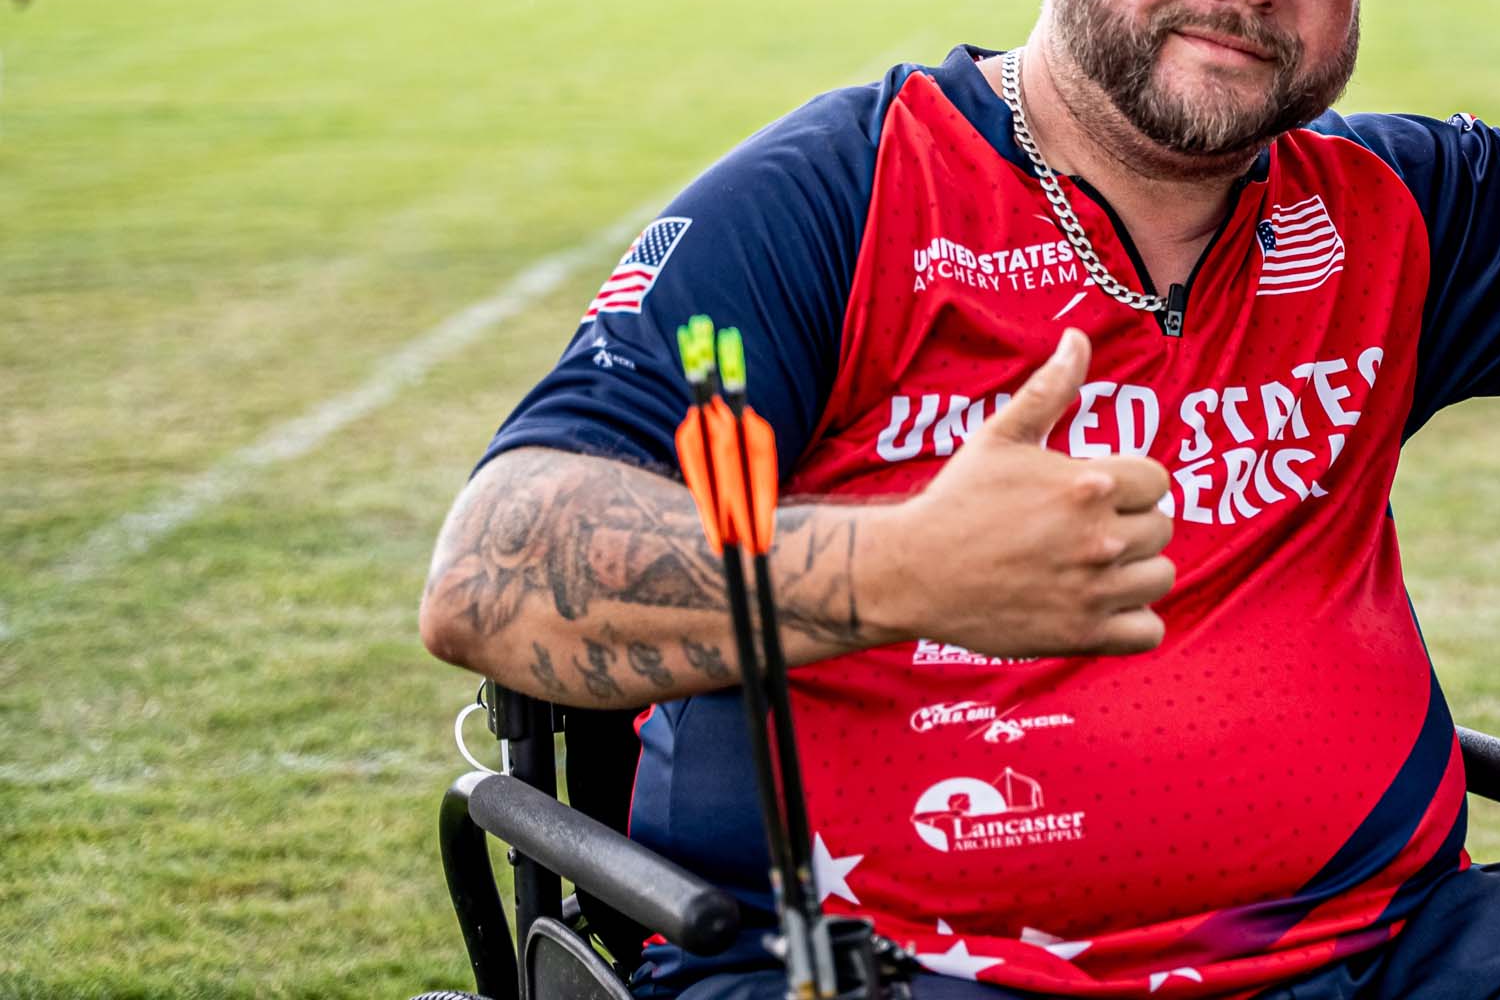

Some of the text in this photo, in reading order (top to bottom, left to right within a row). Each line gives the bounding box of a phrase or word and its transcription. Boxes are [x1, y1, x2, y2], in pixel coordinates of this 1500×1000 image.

[913, 237, 1074, 275] UNITED STATES
[913, 260, 1078, 293] ARCHERY TEAM
[876, 381, 1160, 462] UNED
[1158, 433, 1346, 525] ERIC
[954, 811, 1085, 840] Lancaster
[954, 828, 1083, 851] ARCHERY SUPPLY
